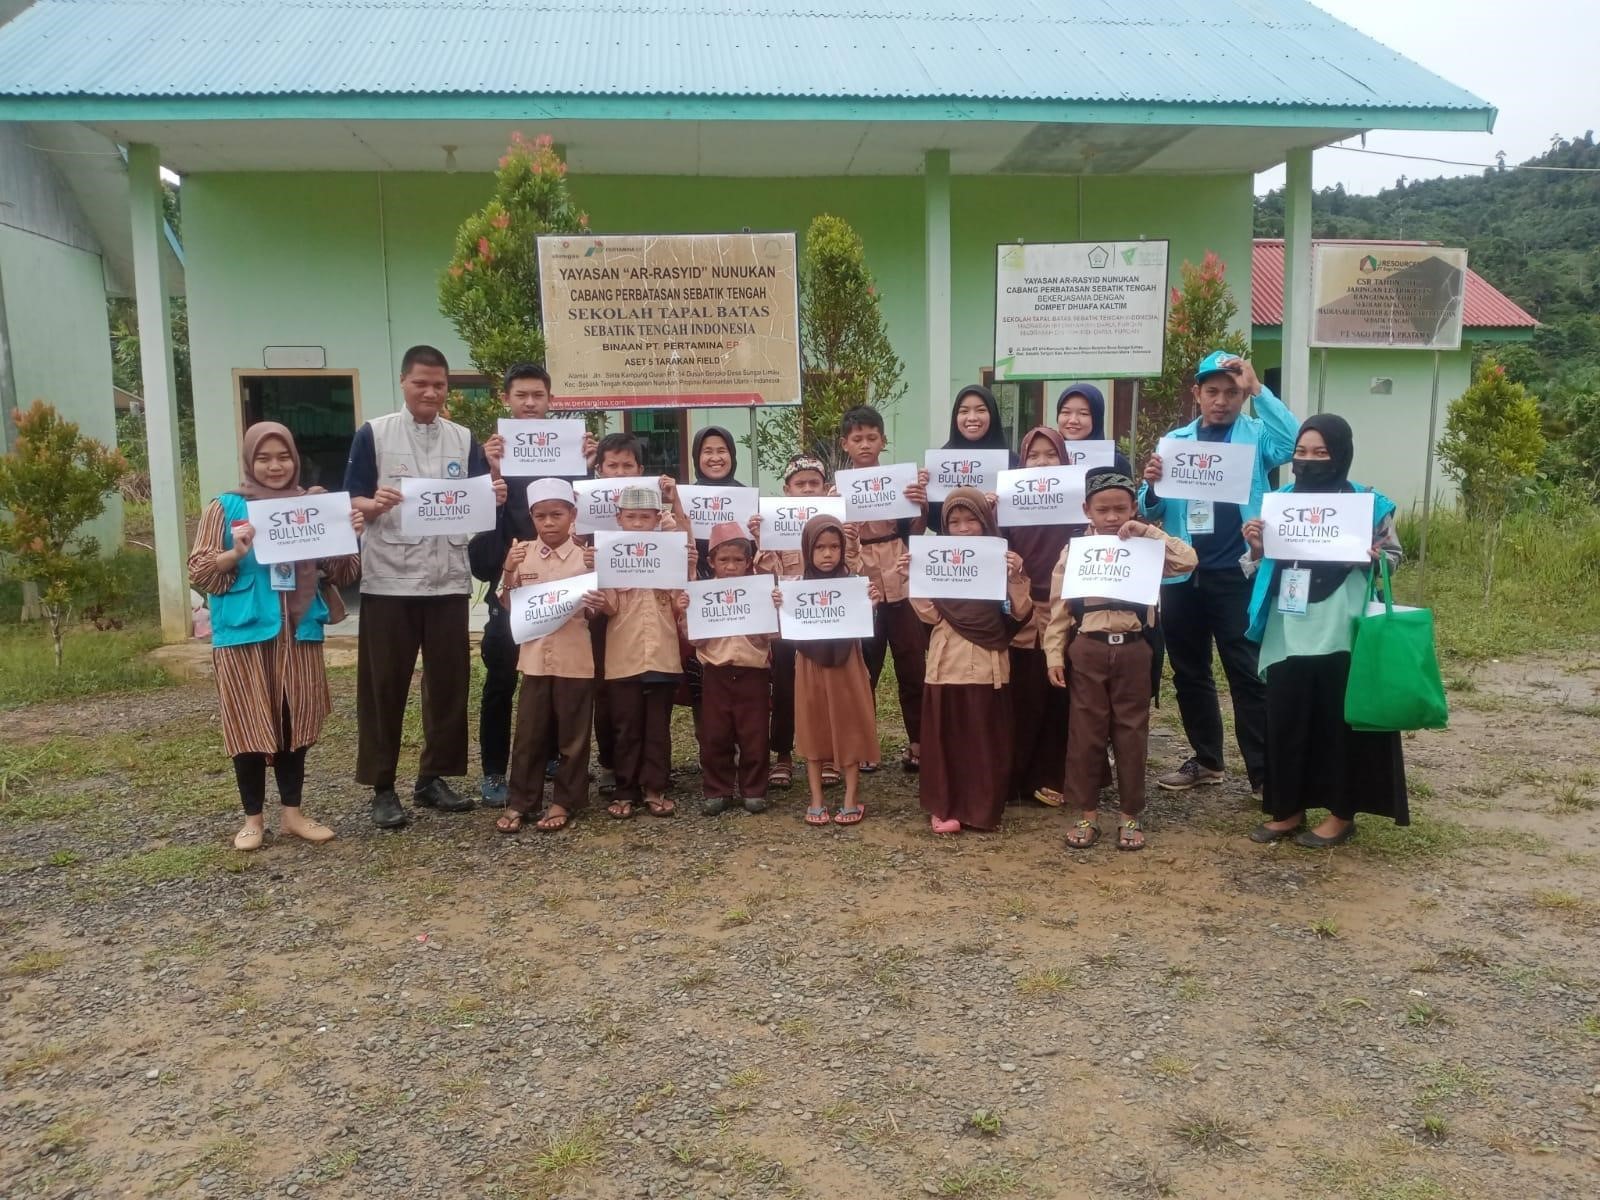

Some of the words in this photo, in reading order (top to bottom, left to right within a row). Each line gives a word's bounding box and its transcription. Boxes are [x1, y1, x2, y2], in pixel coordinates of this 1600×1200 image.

[560, 267, 620, 281] YAYASAN
[712, 265, 776, 278] NUNUKAN
[1024, 277, 1057, 285] YAYASAN
[1059, 276, 1100, 284] AR-RASYID
[1102, 275, 1139, 283] NUNUKAN
[570, 289, 614, 302] CABANG
[615, 287, 681, 302] PERBATASAN
[684, 287, 724, 300] SEBATIK
[726, 286, 767, 299] TENGAH
[1040, 285, 1090, 293] PERBATASAN
[1092, 285, 1123, 293] SEBATIK
[1125, 284, 1157, 292] TENGAH
[1037, 294, 1092, 303] BEKERJASAMA
[1093, 293, 1125, 301] DENGAN
[568, 306, 653, 320] SEKOLAH
[658, 305, 712, 319] TAPAL
[717, 304, 770, 318] BATAS
[1034, 303, 1066, 311] DOMPET
[1067, 302, 1099, 310] DHUAFA
[1100, 301, 1128, 310] KALTIM
[583, 324, 635, 337] SEBATIK
[638, 323, 688, 336] TENGAH
[691, 322, 755, 335] INDONESIA
[602, 343, 642, 351] BINAAN
[663, 341, 724, 351] PERTAMINA
[625, 358, 646, 366] ASET
[656, 357, 695, 366] TARAKAN
[696, 356, 721, 365] FIELD
[513, 446, 561, 458] BULLYING
[938, 474, 984, 484] BULLYING
[1170, 466, 1224, 482] BULLYING
[851, 490, 897, 505] BULLYING
[1012, 493, 1064, 506] BULLYING
[418, 504, 471, 517] BULLYING
[589, 503, 618, 516] BULLY
[689, 509, 734, 522] BULLYING
[269, 522, 326, 541] BULLYING
[774, 520, 804, 532] BULLY
[1278, 524, 1340, 538] BULLYING
[610, 557, 661, 569] BULLYING
[925, 564, 978, 577] BULLYING
[1078, 564, 1131, 578] BULLYING
[524, 600, 574, 622] BULLYING
[701, 603, 751, 618] BULLYING
[794, 605, 846, 620] BULLYING
